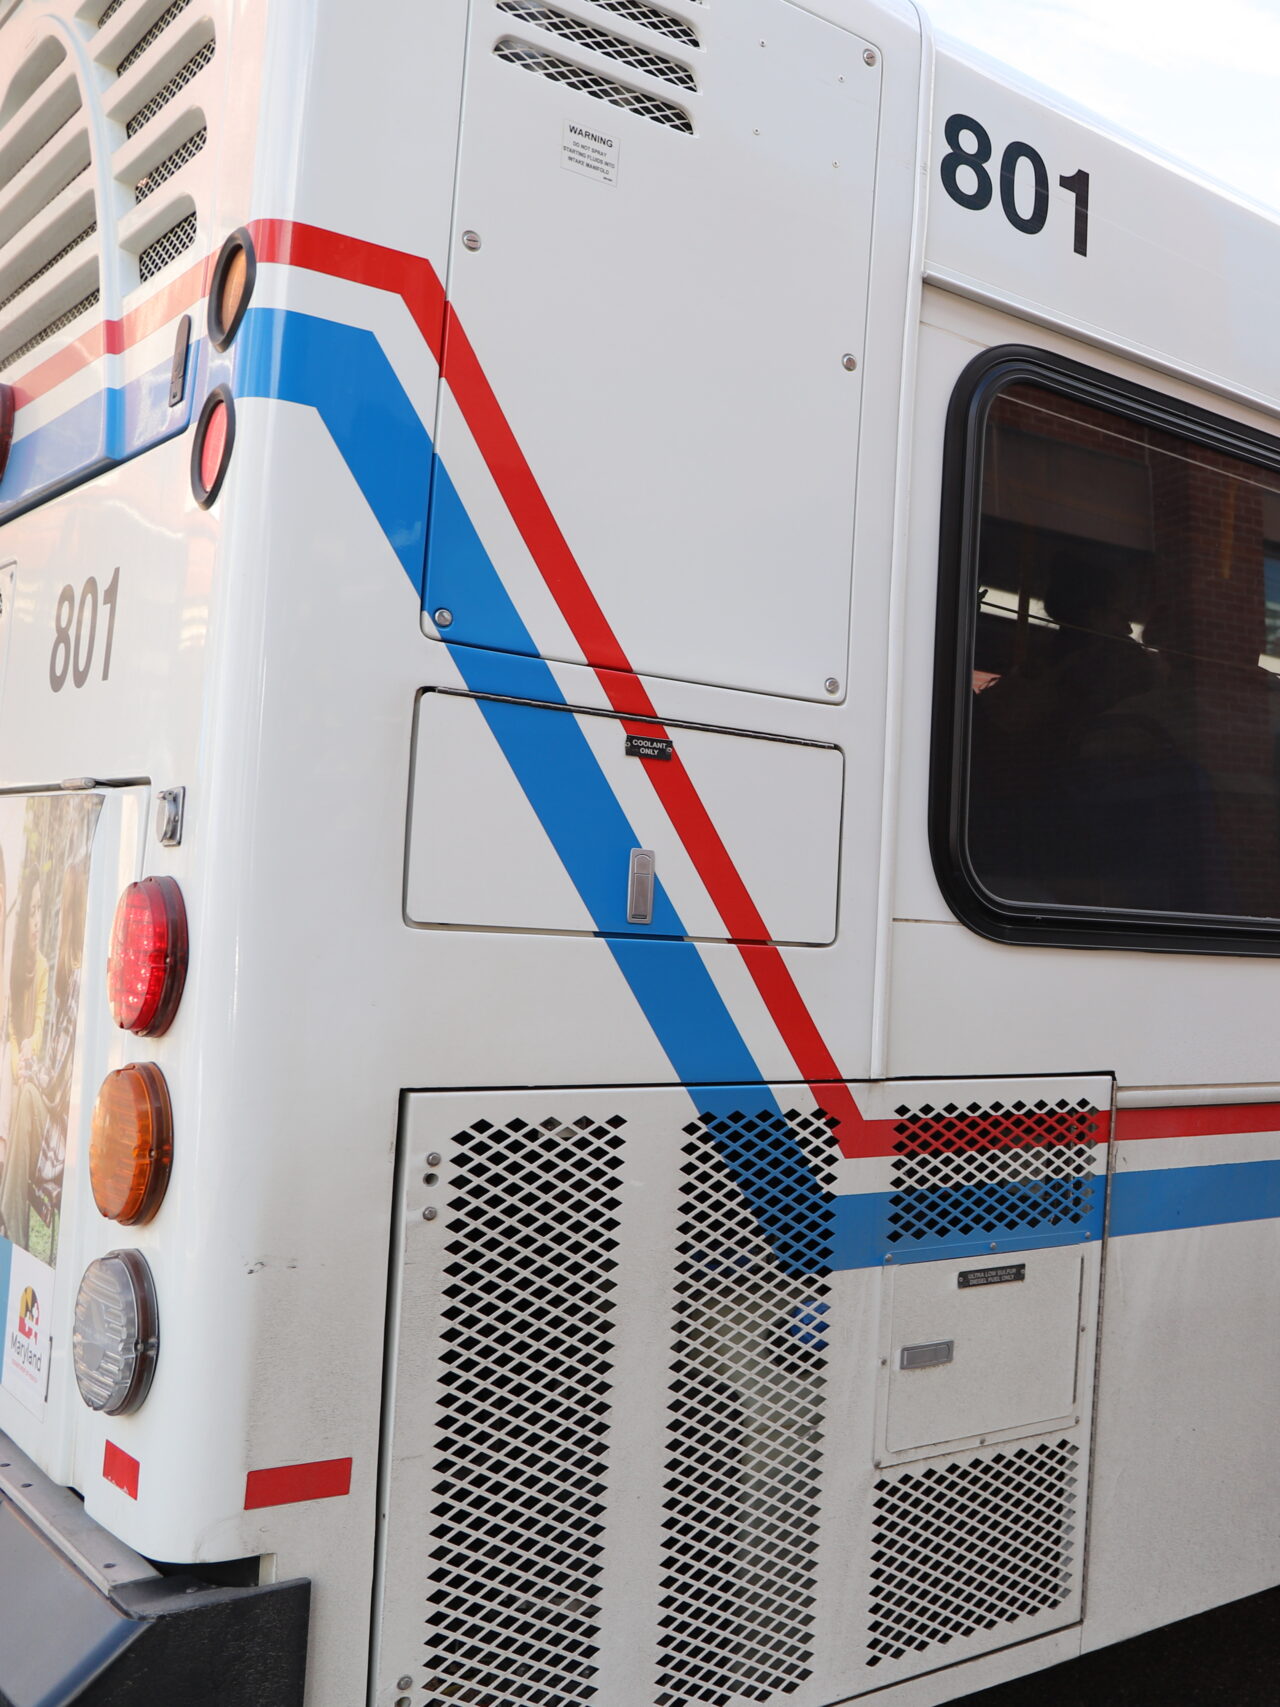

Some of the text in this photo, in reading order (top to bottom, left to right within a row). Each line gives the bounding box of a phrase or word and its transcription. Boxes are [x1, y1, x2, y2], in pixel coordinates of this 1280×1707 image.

[569, 124, 614, 148] WARNING
[940, 113, 1090, 258] 801
[49, 566, 121, 693] 801
[632, 739, 667, 749] COOLANT
[639, 747, 659, 756] ONLY
[10, 1331, 43, 1373] Maryland
